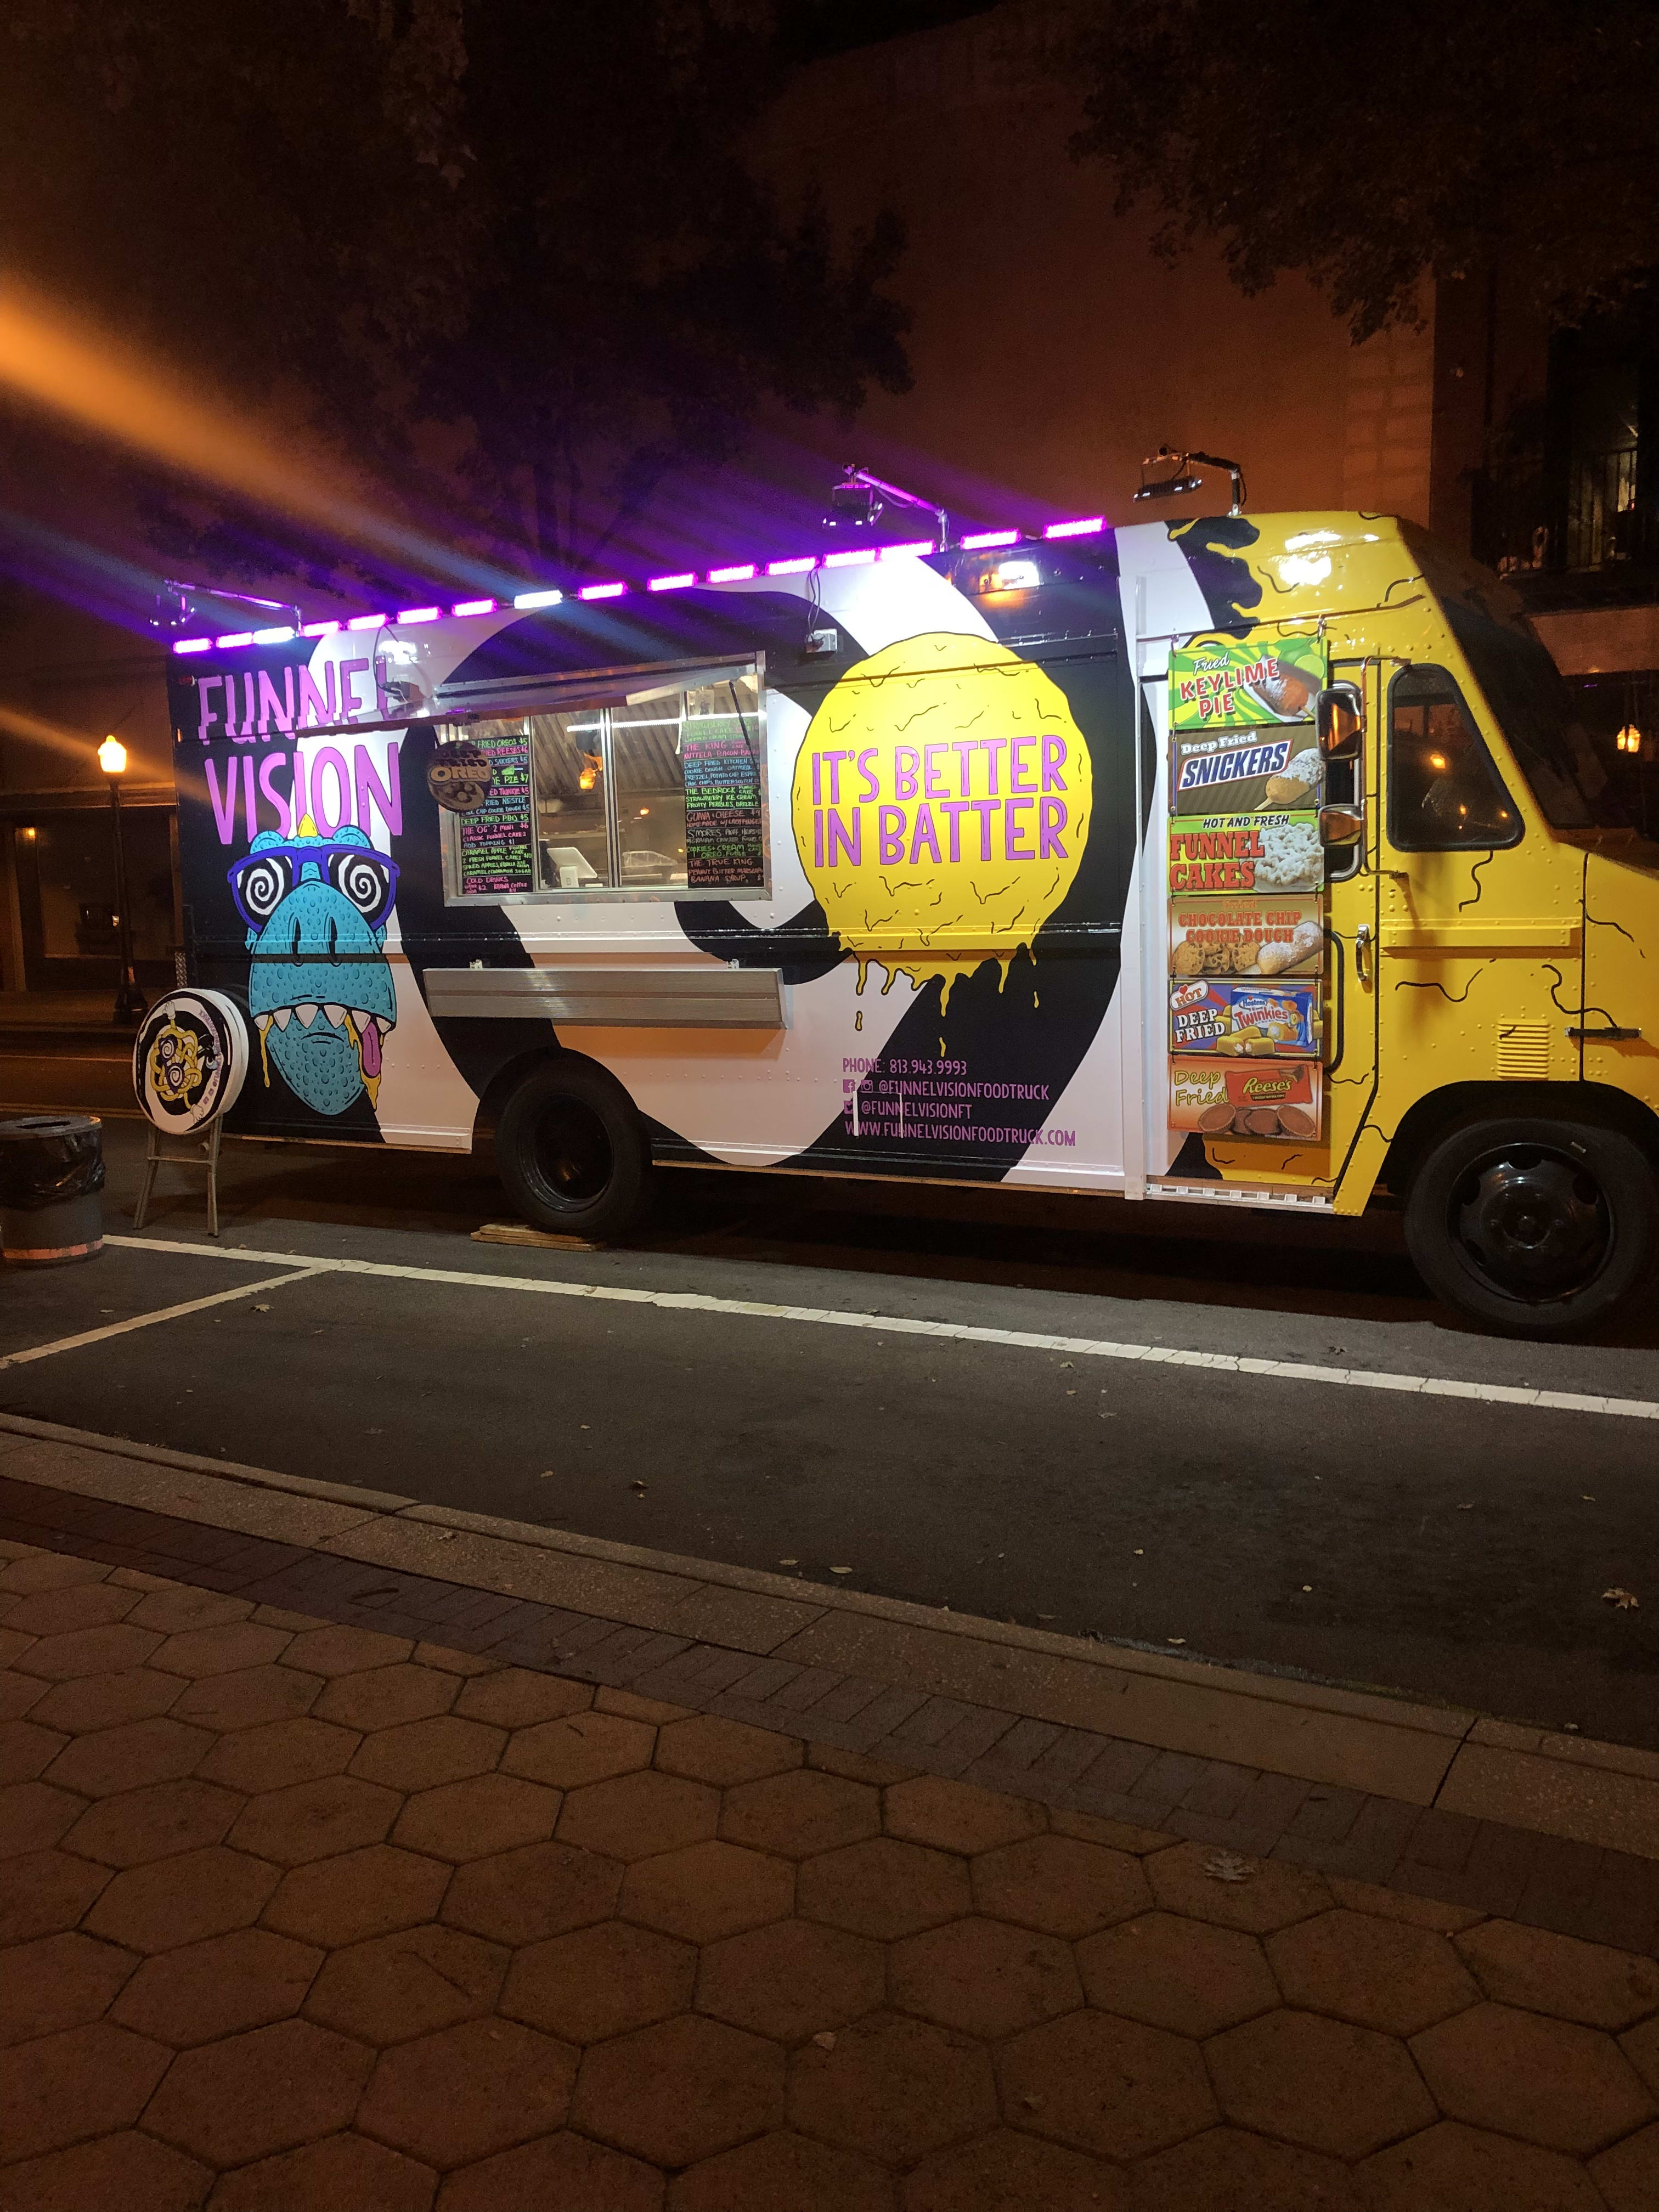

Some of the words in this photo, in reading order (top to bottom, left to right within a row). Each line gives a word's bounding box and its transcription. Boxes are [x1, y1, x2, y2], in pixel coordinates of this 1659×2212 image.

[1193, 651, 1231, 675] Fried
[1180, 658, 1280, 701] KEYLIME
[198, 656, 390, 744] FUNNEL
[1198, 693, 1235, 719] PIE
[478, 740, 495, 748] FRIED
[496, 738, 517, 747] OREOS
[519, 737, 528, 745] $5
[496, 747, 521, 756] REESES
[705, 742, 727, 750] KING
[1181, 741, 1218, 755] Deep
[1218, 731, 1258, 749] Fried
[431, 765, 489, 782] OREO
[812, 748, 880, 805] IT'S
[895, 735, 1068, 800] BETTER
[1181, 742, 1289, 788] SNICKERS
[504, 775, 519, 783] PIE
[520, 773, 529, 783] $7
[204, 742, 402, 845] VISION
[701, 787, 736, 795] BEDROCK
[686, 812, 711, 822] GUAVA
[715, 810, 746, 819] CHEESE
[1203, 817, 1226, 829] HOT
[1227, 816, 1251, 828] AND
[1253, 815, 1290, 826] FRESH
[461, 826, 474, 836] THE
[814, 807, 861, 867] IN
[879, 797, 1069, 865] BATTER
[1170, 831, 1265, 861] FUNNEL
[707, 859, 731, 867] TRUE
[1170, 861, 1256, 890] CAKES
[1178, 911, 1262, 927] CHOCOLATE
[1265, 910, 1302, 926] CHIP
[1186, 928, 1241, 944] COOKIE
[1243, 927, 1295, 944] DOUGH
[1175, 986, 1203, 1007] HOT
[1176, 1008, 1218, 1029] DEEP
[1234, 1005, 1289, 1029] Twinkies
[1175, 1022, 1226, 1043] FRIED
[843, 1058, 885, 1073] PHONE:
[889, 1059, 967, 1076] 813.943.9993
[1173, 1070, 1221, 1089] Deep
[1242, 1077, 1293, 1094] Reese's
[879, 1080, 1049, 1101] @FUNNELVISIONFOODTRUCK
[1175, 1086, 1230, 1107] Fried
[861, 1101, 972, 1120] @FUNNELVISIONFT
